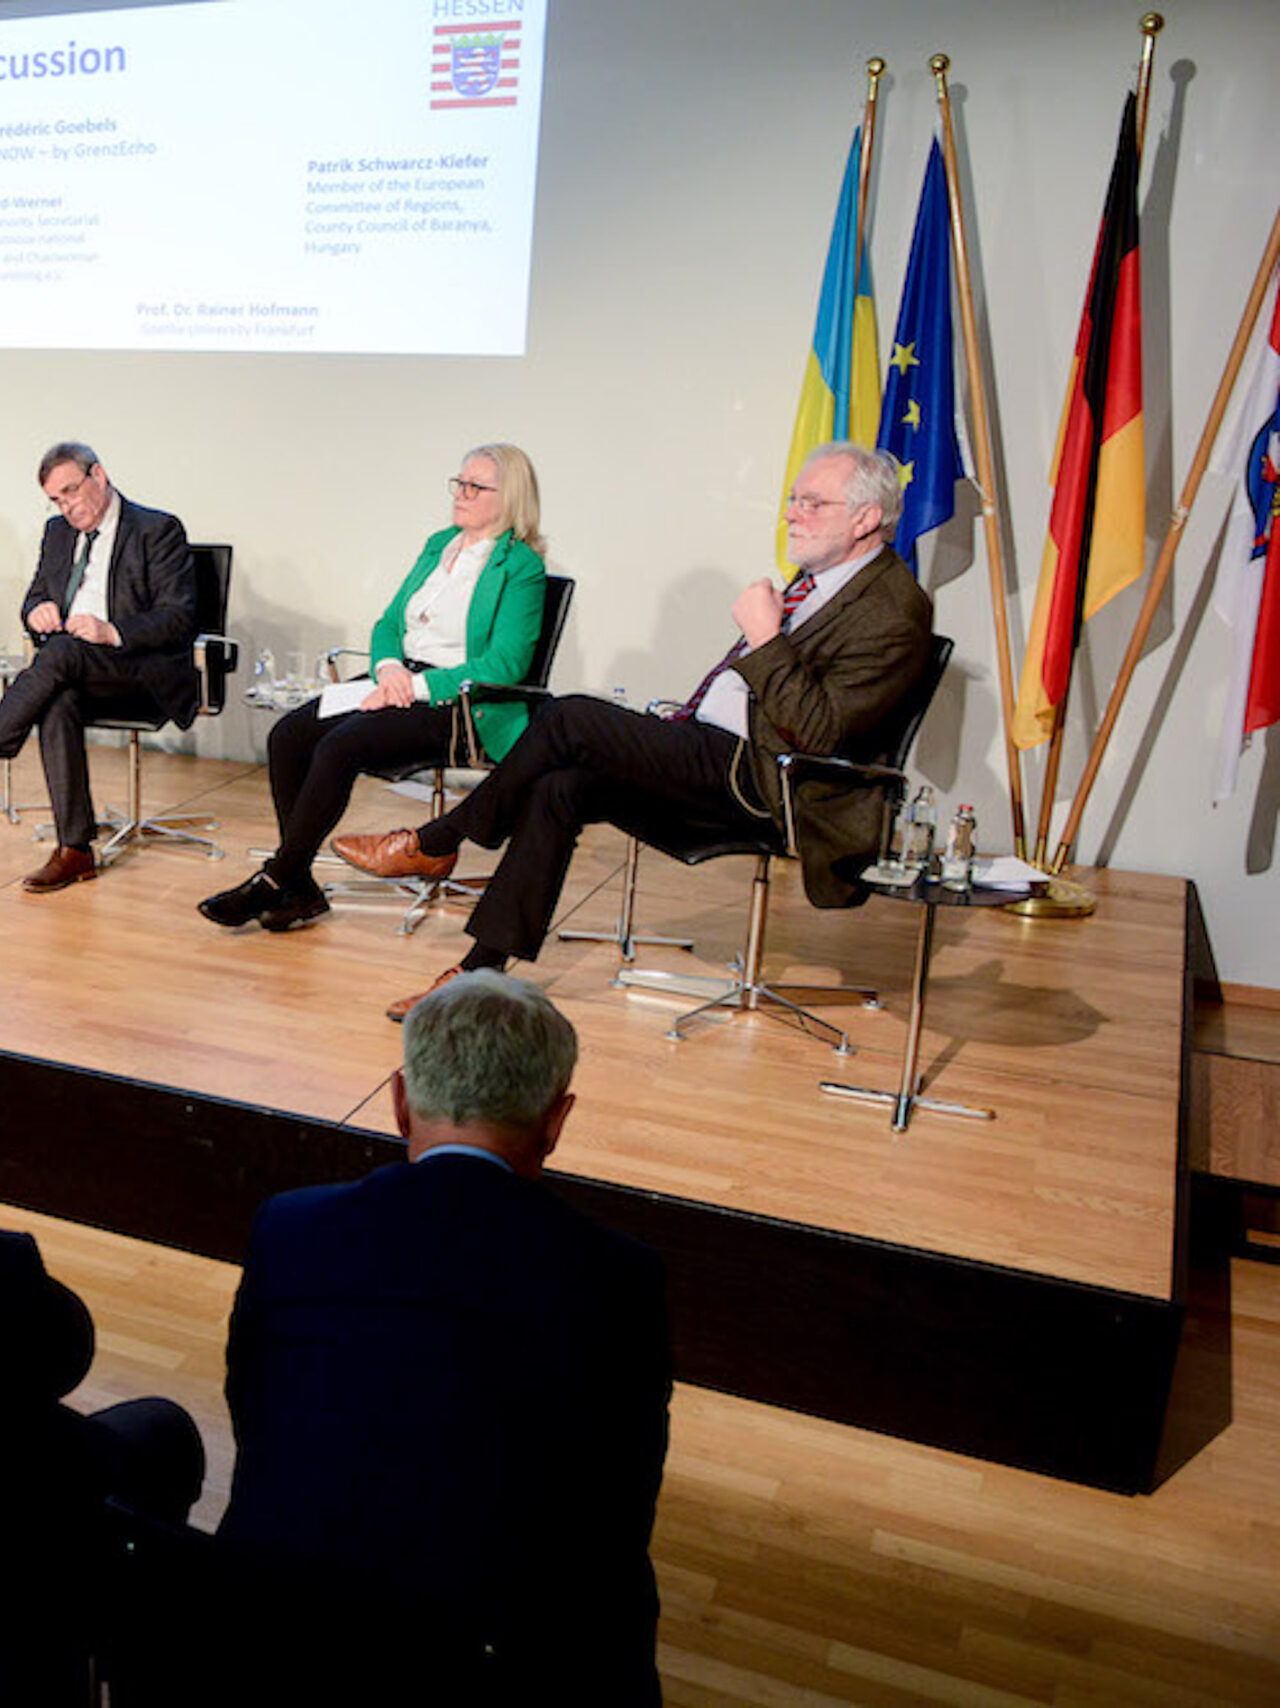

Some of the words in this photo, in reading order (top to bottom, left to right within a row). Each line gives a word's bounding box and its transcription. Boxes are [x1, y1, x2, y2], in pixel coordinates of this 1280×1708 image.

[433, 0, 524, 17] HESSEN
[54, 116, 118, 136] Goebels
[52, 142, 70, 161] by
[74, 138, 158, 159] GrenzEcho
[307, 157, 353, 173] Patrik
[357, 153, 489, 172] Schwarcz-Kiefer
[306, 178, 365, 194] Member
[368, 178, 384, 193] of
[386, 178, 410, 192] the
[414, 177, 485, 193] European
[305, 199, 381, 214] Committee
[384, 198, 400, 213] of
[403, 197, 463, 214] Regions,
[304, 219, 354, 235] County
[356, 218, 409, 233] Council
[411, 218, 426, 233] of
[429, 217, 492, 234] Baranya,
[304, 240, 361, 257] Hungary
[136, 302, 170, 317] Prof.
[173, 302, 193, 317] Dr.
[196, 302, 245, 317] Rainer
[249, 301, 320, 317] Hofmann
